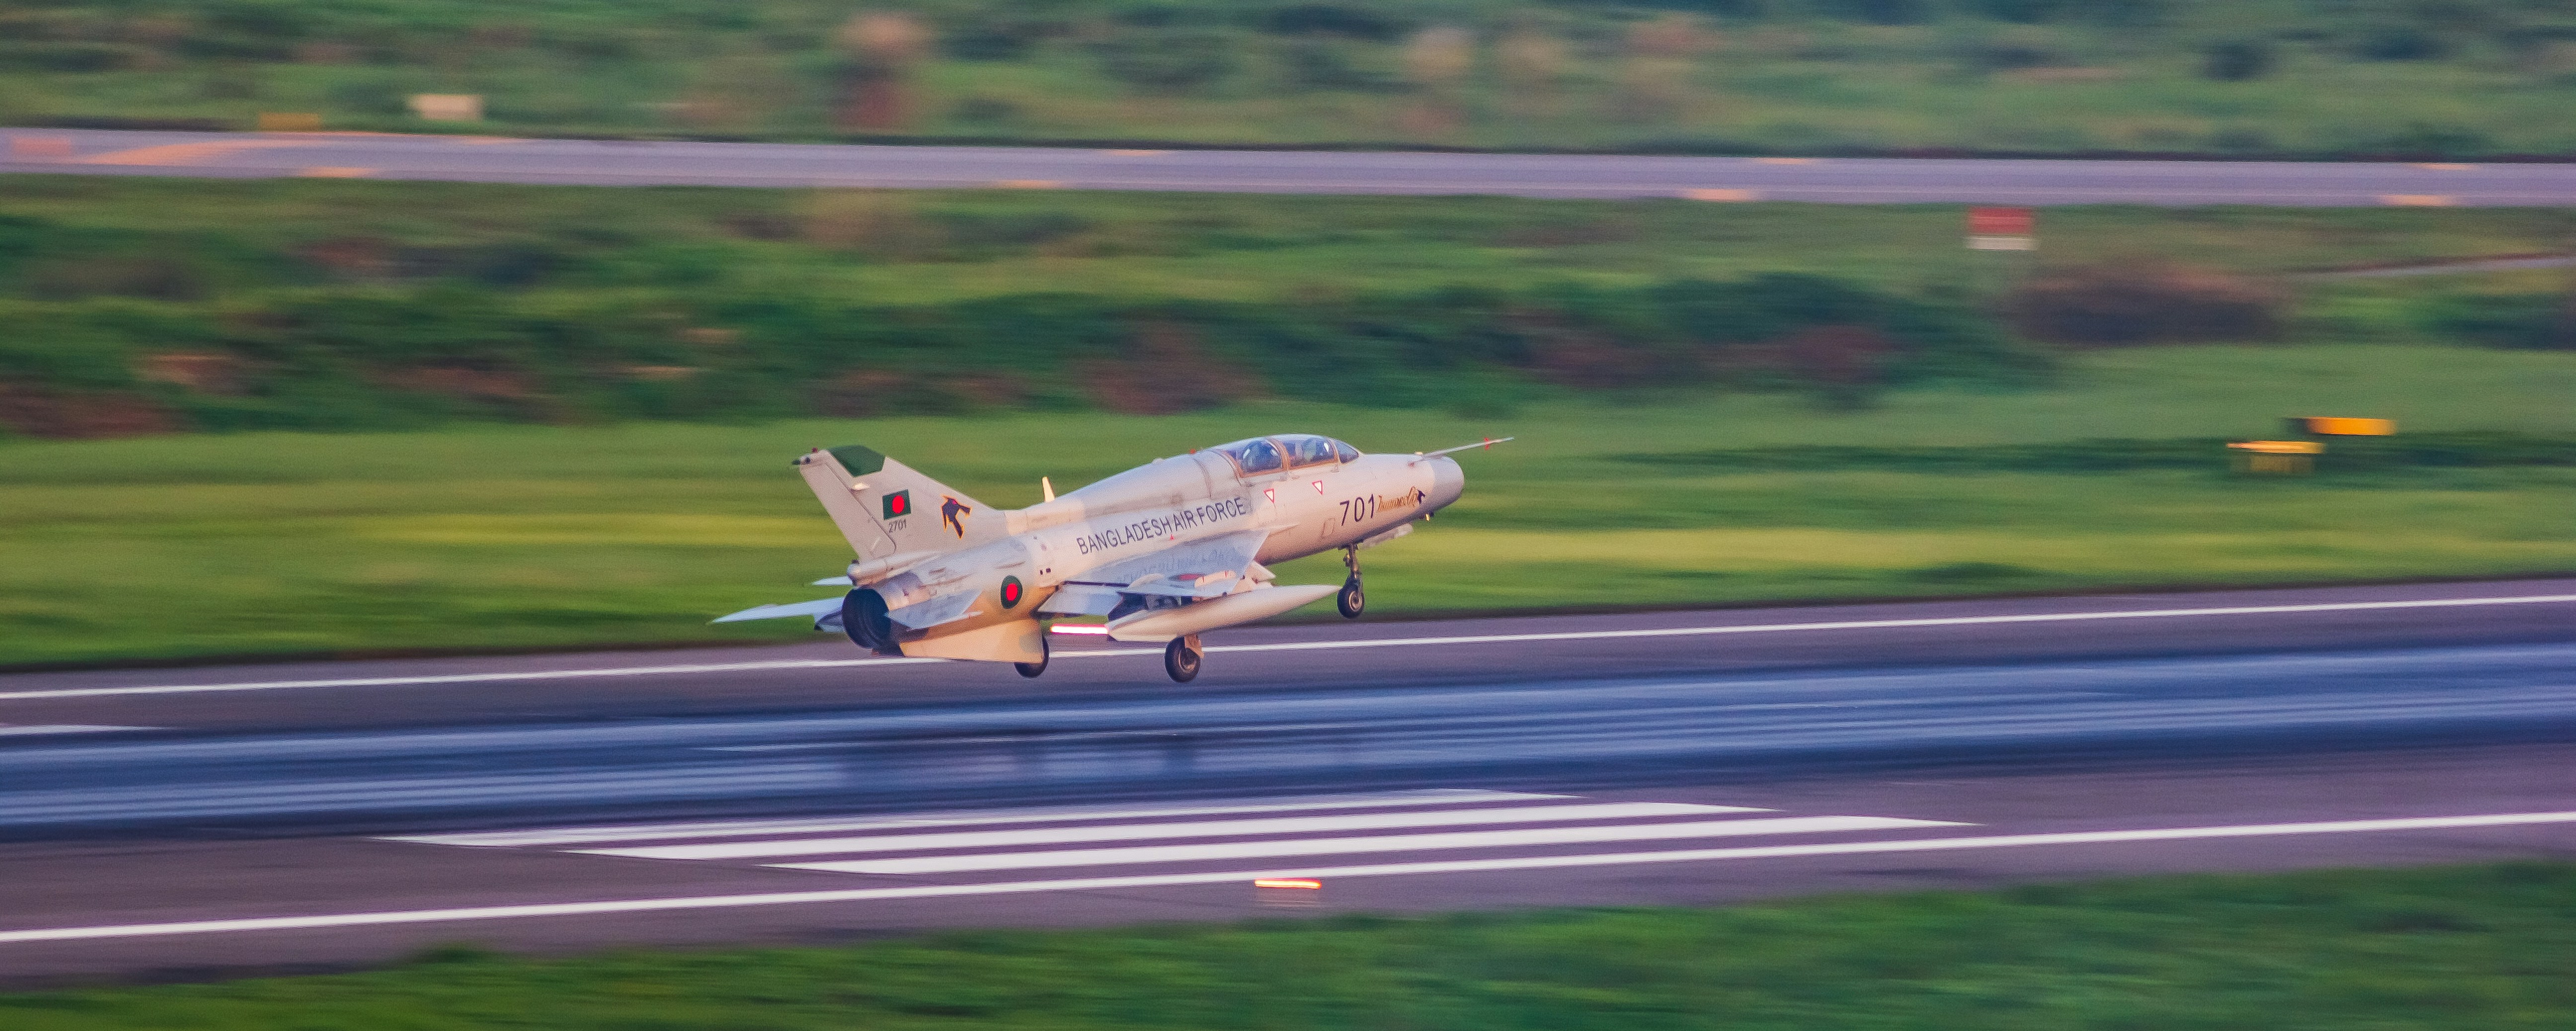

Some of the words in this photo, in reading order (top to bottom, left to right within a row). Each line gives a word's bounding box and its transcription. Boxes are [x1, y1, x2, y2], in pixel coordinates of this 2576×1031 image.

[888, 518, 907, 532] 2701
[1076, 515, 1173, 555] BANGLADESH
[1173, 510, 1198, 531] AIR
[1197, 497, 1246, 525] FORCE
[1340, 494, 1374, 526] 701
